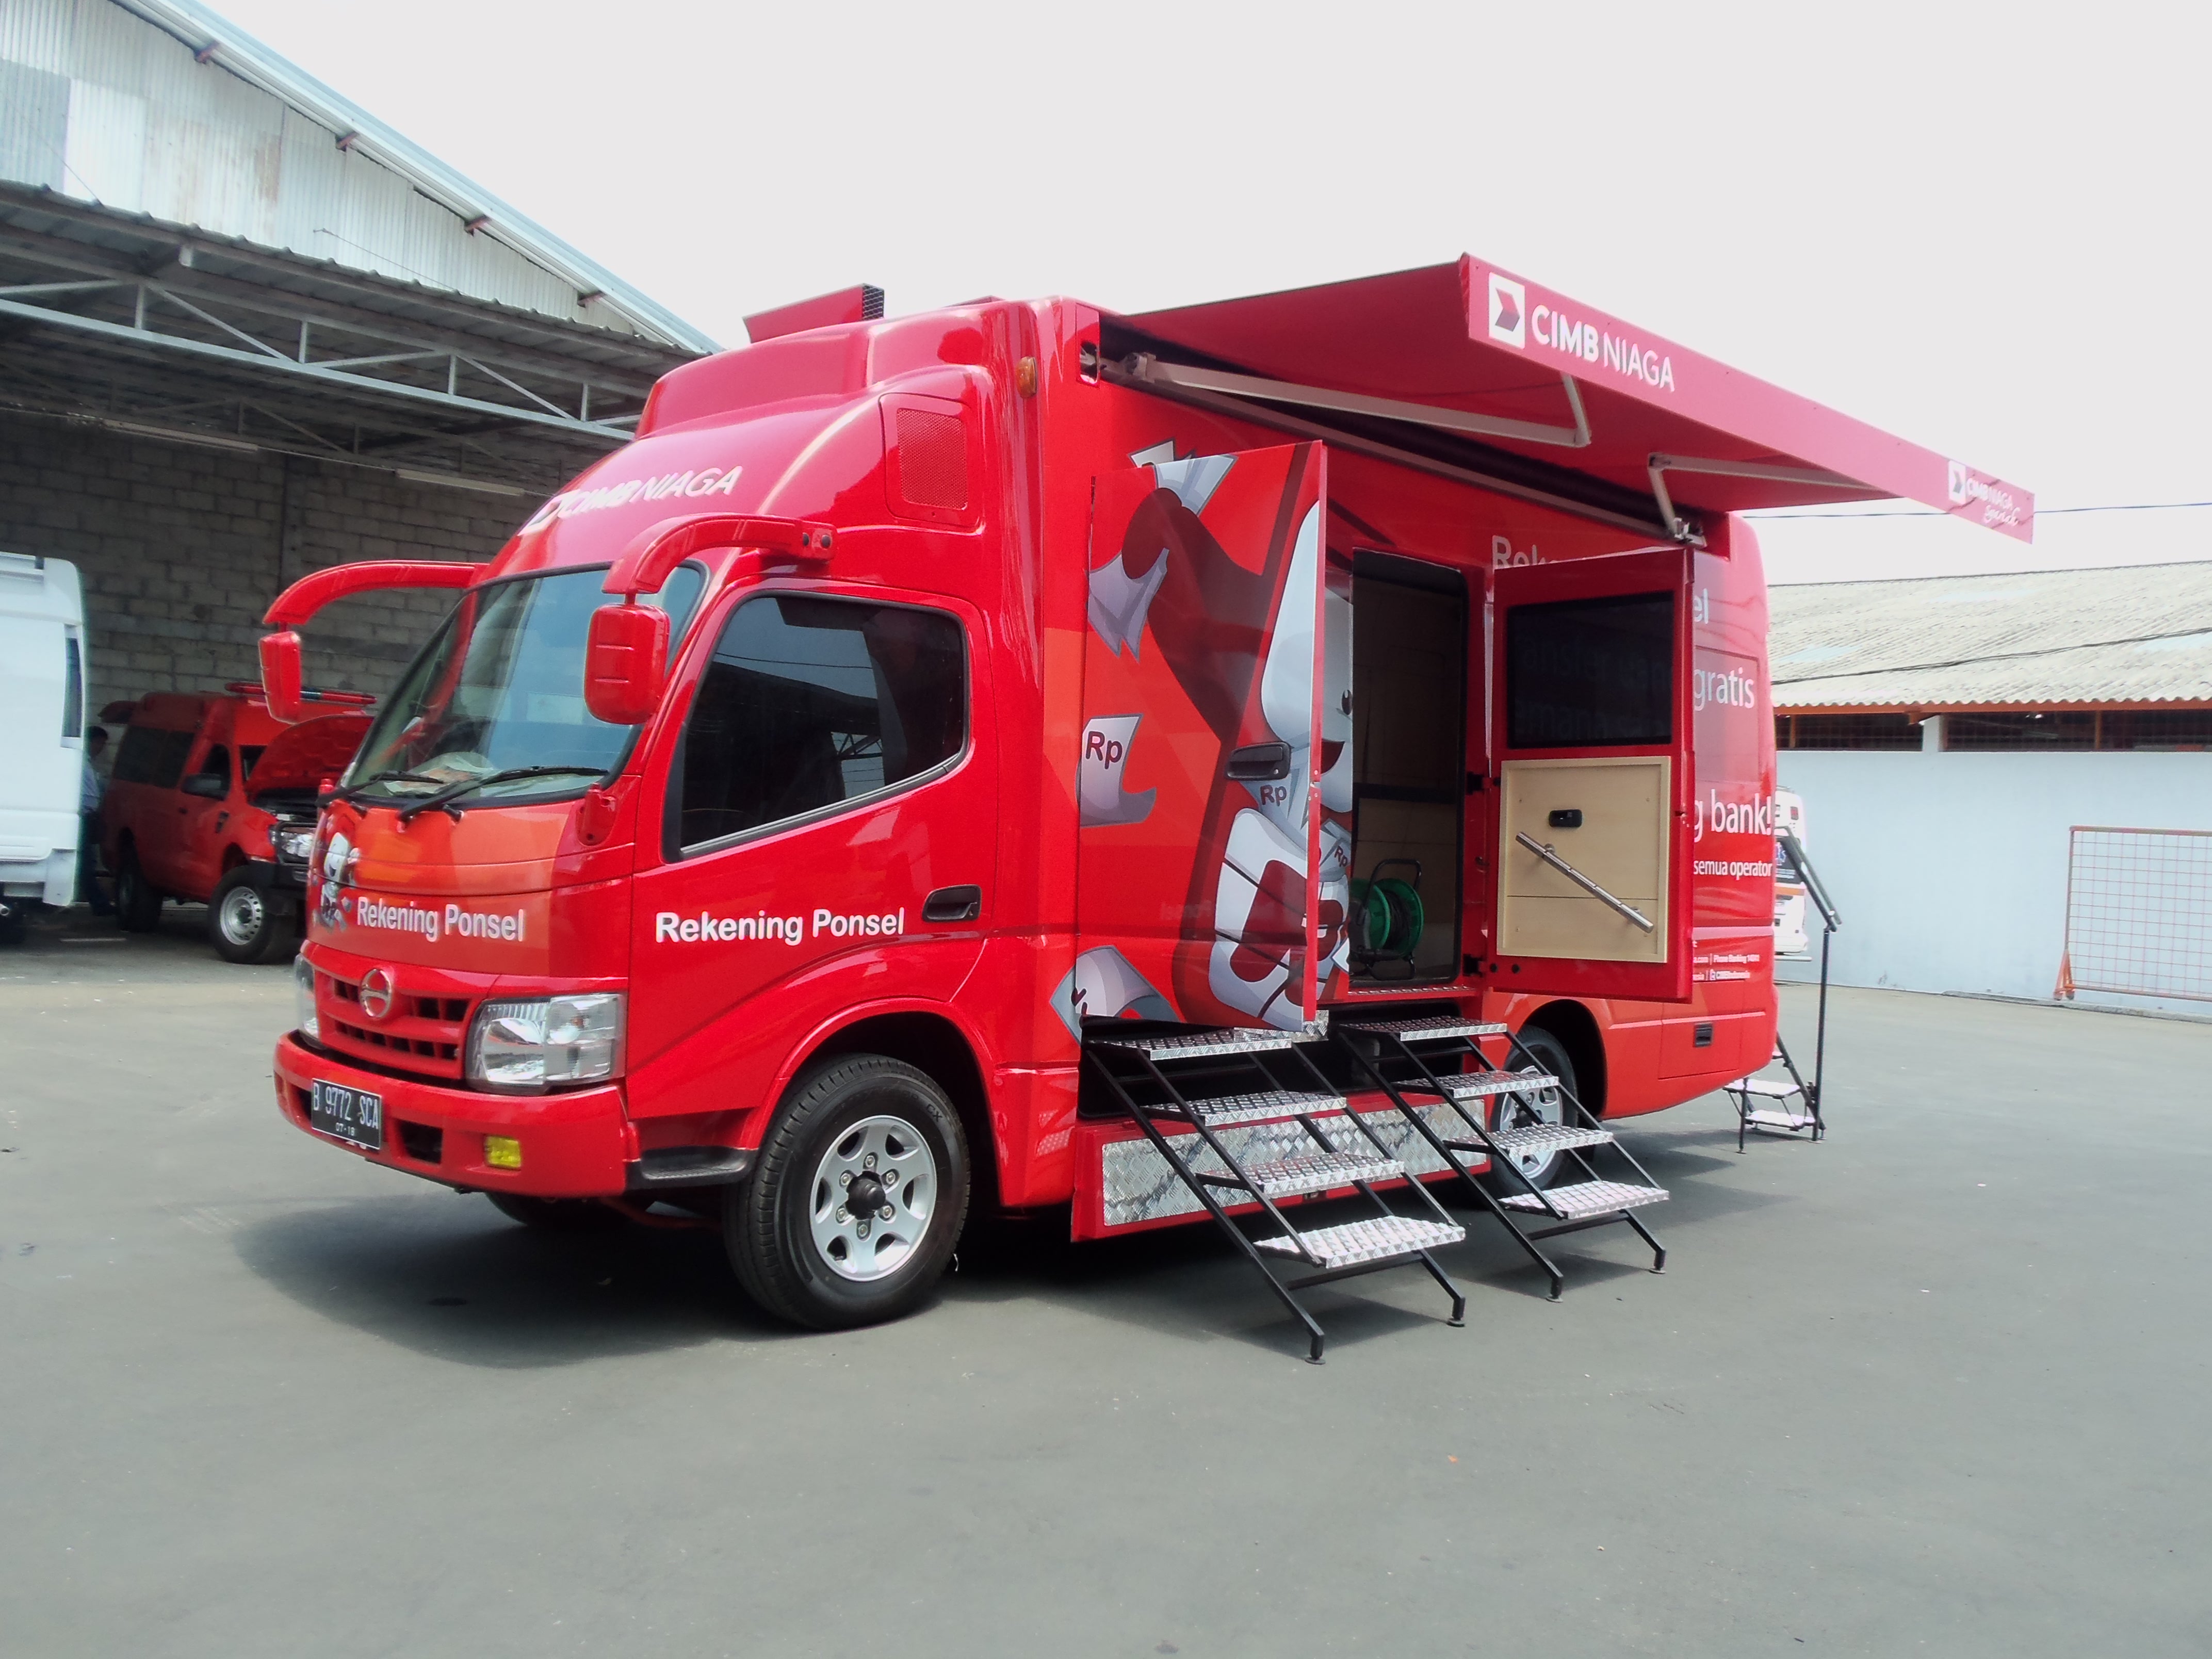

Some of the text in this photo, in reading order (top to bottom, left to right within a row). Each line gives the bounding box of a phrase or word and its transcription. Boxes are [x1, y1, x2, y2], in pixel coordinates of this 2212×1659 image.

[1532, 304, 1675, 392] CIMB NIAGA
[629, 465, 743, 502] NIAGA
[1694, 667, 1754, 711] gratis
[1085, 730, 1123, 769] Rp
[1260, 784, 1287, 805] Rp
[1711, 789, 1771, 835] bank!
[1334, 845, 1347, 867] Rp
[1694, 860, 1728, 875] semua
[1730, 860, 1772, 881] operator
[357, 896, 525, 942] Rekening Ponsel
[656, 907, 904, 946] Rekening Ponsel
[313, 1083, 379, 1129] B 9772 SCA
